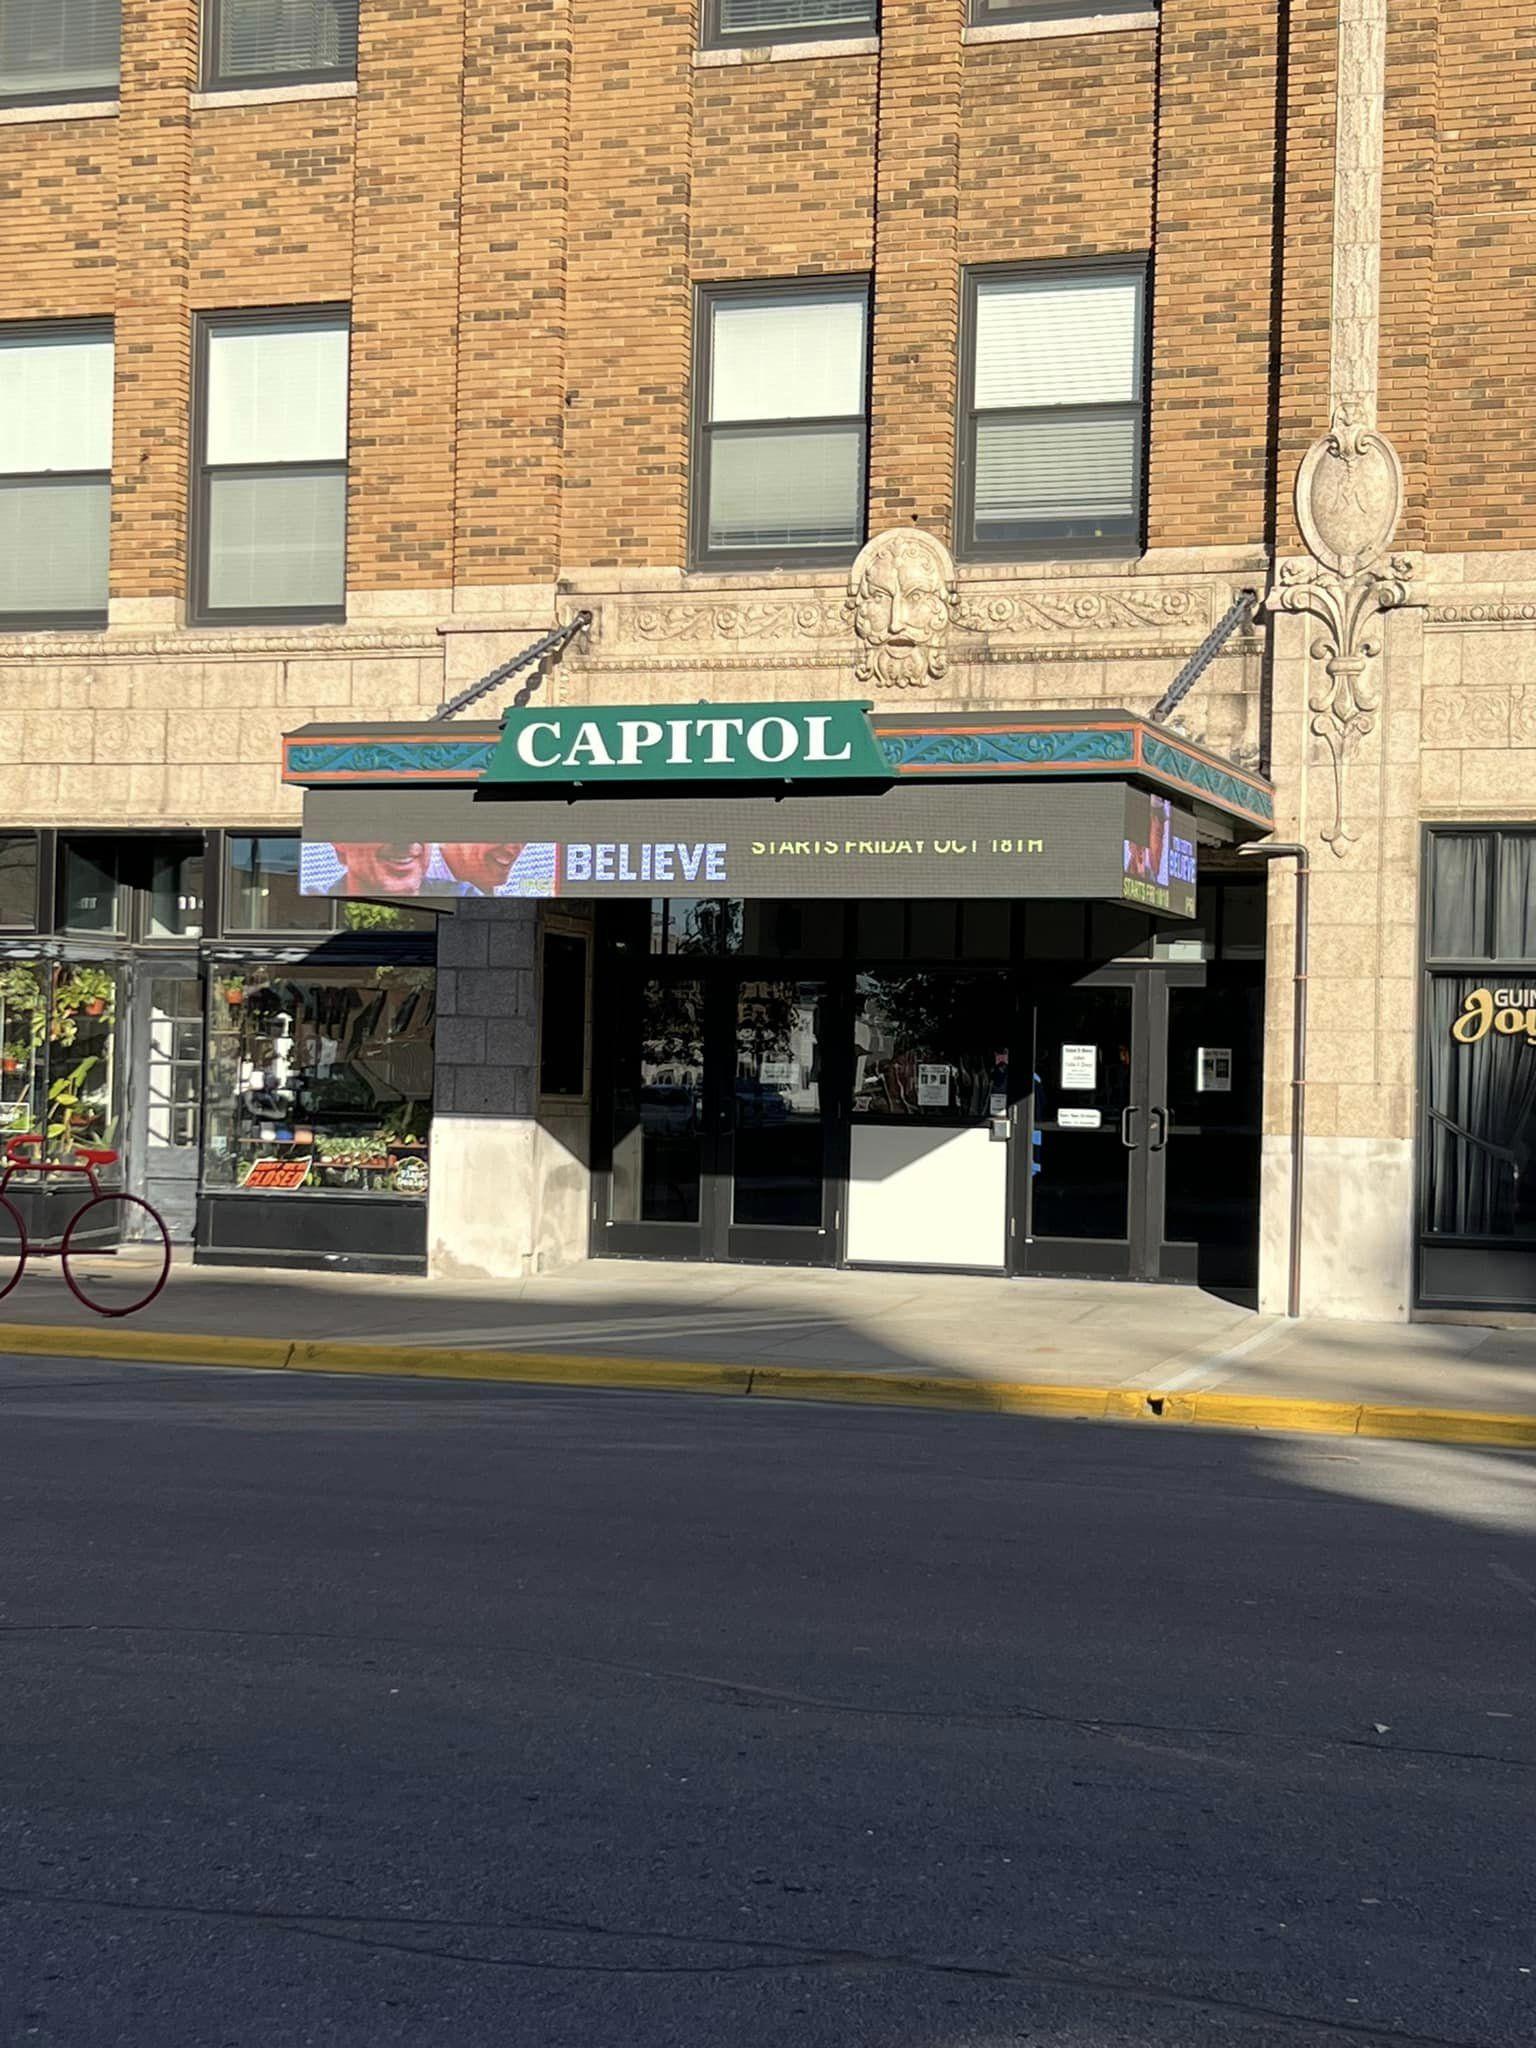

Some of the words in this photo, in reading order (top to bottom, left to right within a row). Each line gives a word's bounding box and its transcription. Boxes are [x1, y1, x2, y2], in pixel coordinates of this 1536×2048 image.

[516, 715, 852, 768] CAPITOL
[844, 840, 925, 854] FRIDAY
[566, 842, 728, 881] BELIEVE
[244, 1170, 306, 1188] CLOSED
